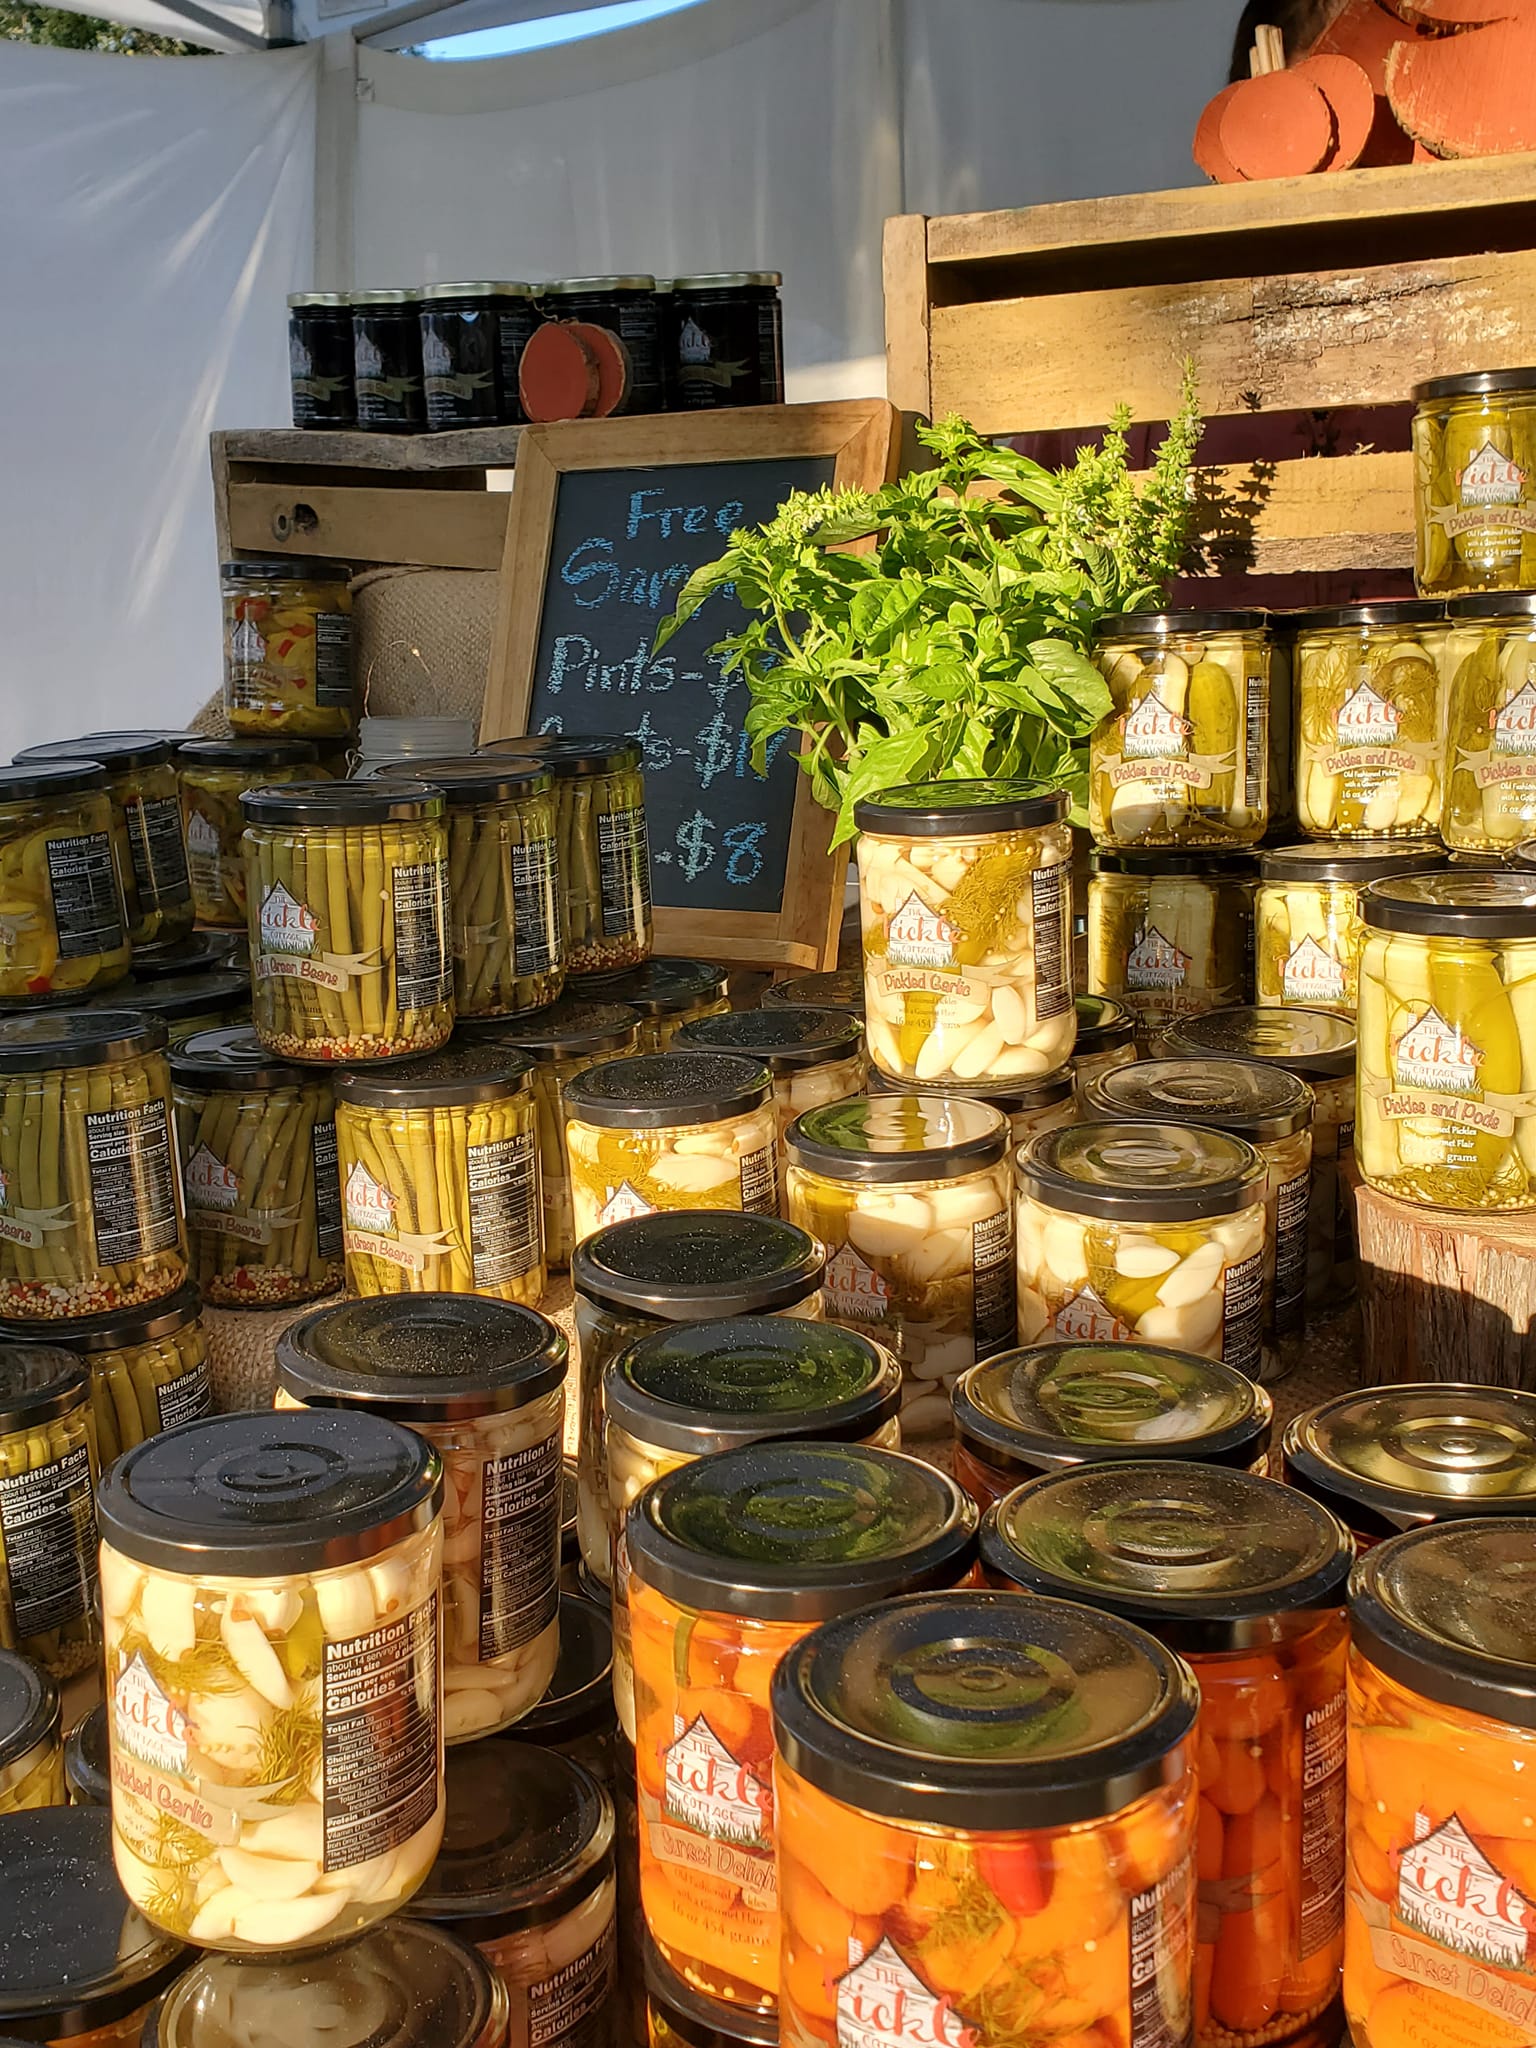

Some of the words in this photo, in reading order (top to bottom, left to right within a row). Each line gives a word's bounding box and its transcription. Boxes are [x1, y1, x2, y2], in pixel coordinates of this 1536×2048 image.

[628, 489, 744, 540] Free
[1325, 753, 1361, 772] Pickles
[1365, 752, 1385, 765] and
[1388, 752, 1416, 770] Pods
[1480, 761, 1521, 783] Pickles
[1114, 765, 1147, 783] Pickles
[1150, 764, 1169, 777] and
[1173, 764, 1200, 783] Pods
[599, 811, 633, 824] Nutrition
[48, 838, 89, 850] Nutrition
[90, 832, 108, 844] Facts
[513, 842, 547, 855] Nutrition
[600, 838, 631, 851] Calories
[51, 864, 89, 876] Calories
[394, 865, 435, 878] Nutrition
[514, 872, 545, 884] Calories
[395, 898, 433, 909] Calories
[301, 961, 338, 985] Beans
[884, 972, 926, 991] Pickled
[930, 973, 971, 997] Garlic
[87, 1108, 141, 1126] Nutrition
[143, 1100, 165, 1116] Facts
[1383, 1095, 1426, 1116] Pickles
[1431, 1100, 1458, 1119] and
[1461, 1102, 1501, 1130] Pods
[90, 1143, 138, 1159] Calories
[161, 1129, 167, 1141] 5
[468, 1141, 514, 1157] Nutrition
[1446, 1153, 1478, 1164] grams
[469, 1173, 510, 1188] Calories
[379, 1239, 414, 1265] Beans
[974, 1246, 1007, 1268] Calories
[1226, 1253, 1261, 1281] Nutrition
[1225, 1294, 1257, 1316] Calories
[158, 1371, 197, 1397] Nutrition
[162, 1405, 197, 1427] Calories
[0, 1464, 59, 1492] Nutrition
[61, 1447, 87, 1470] Facts
[486, 1445, 544, 1477] Nutrition
[3, 1503, 56, 1527] Calories
[84, 1477, 90, 1491] 5
[484, 1492, 537, 1519] Calories
[327, 1622, 405, 1661] Nutrition
[408, 1598, 436, 1631] Facts
[327, 1660, 352, 1674] about
[355, 1656, 364, 1666] 14
[366, 1642, 397, 1663] servings
[326, 1667, 362, 1683] Serving
[364, 1660, 380, 1673] size
[326, 1681, 362, 1698] Amount
[364, 1676, 378, 1690] per
[326, 1679, 396, 1711] Calories
[327, 1723, 349, 1735] Total
[351, 1718, 364, 1729] Fat
[326, 1745, 375, 1766] Cholesterol
[692, 1739, 713, 1757] THE
[326, 1761, 359, 1775] Sodium
[327, 1773, 351, 1786] Total
[352, 1749, 405, 1778] Carbohydrate
[157, 1783, 213, 1830] Garlic
[682, 1793, 742, 1826] COTTAGE
[327, 1813, 358, 1828] Protein
[661, 1827, 713, 1867] Sunset
[717, 1845, 777, 1892] Deligh
[1440, 1842, 1468, 1864] THE
[1423, 1901, 1500, 1945] COTTAGE
[1391, 1934, 1461, 1990] Sunset
[531, 1950, 593, 2000] Nutrition
[876, 1967, 904, 1987] THE
[531, 2001, 587, 2042] Calories
